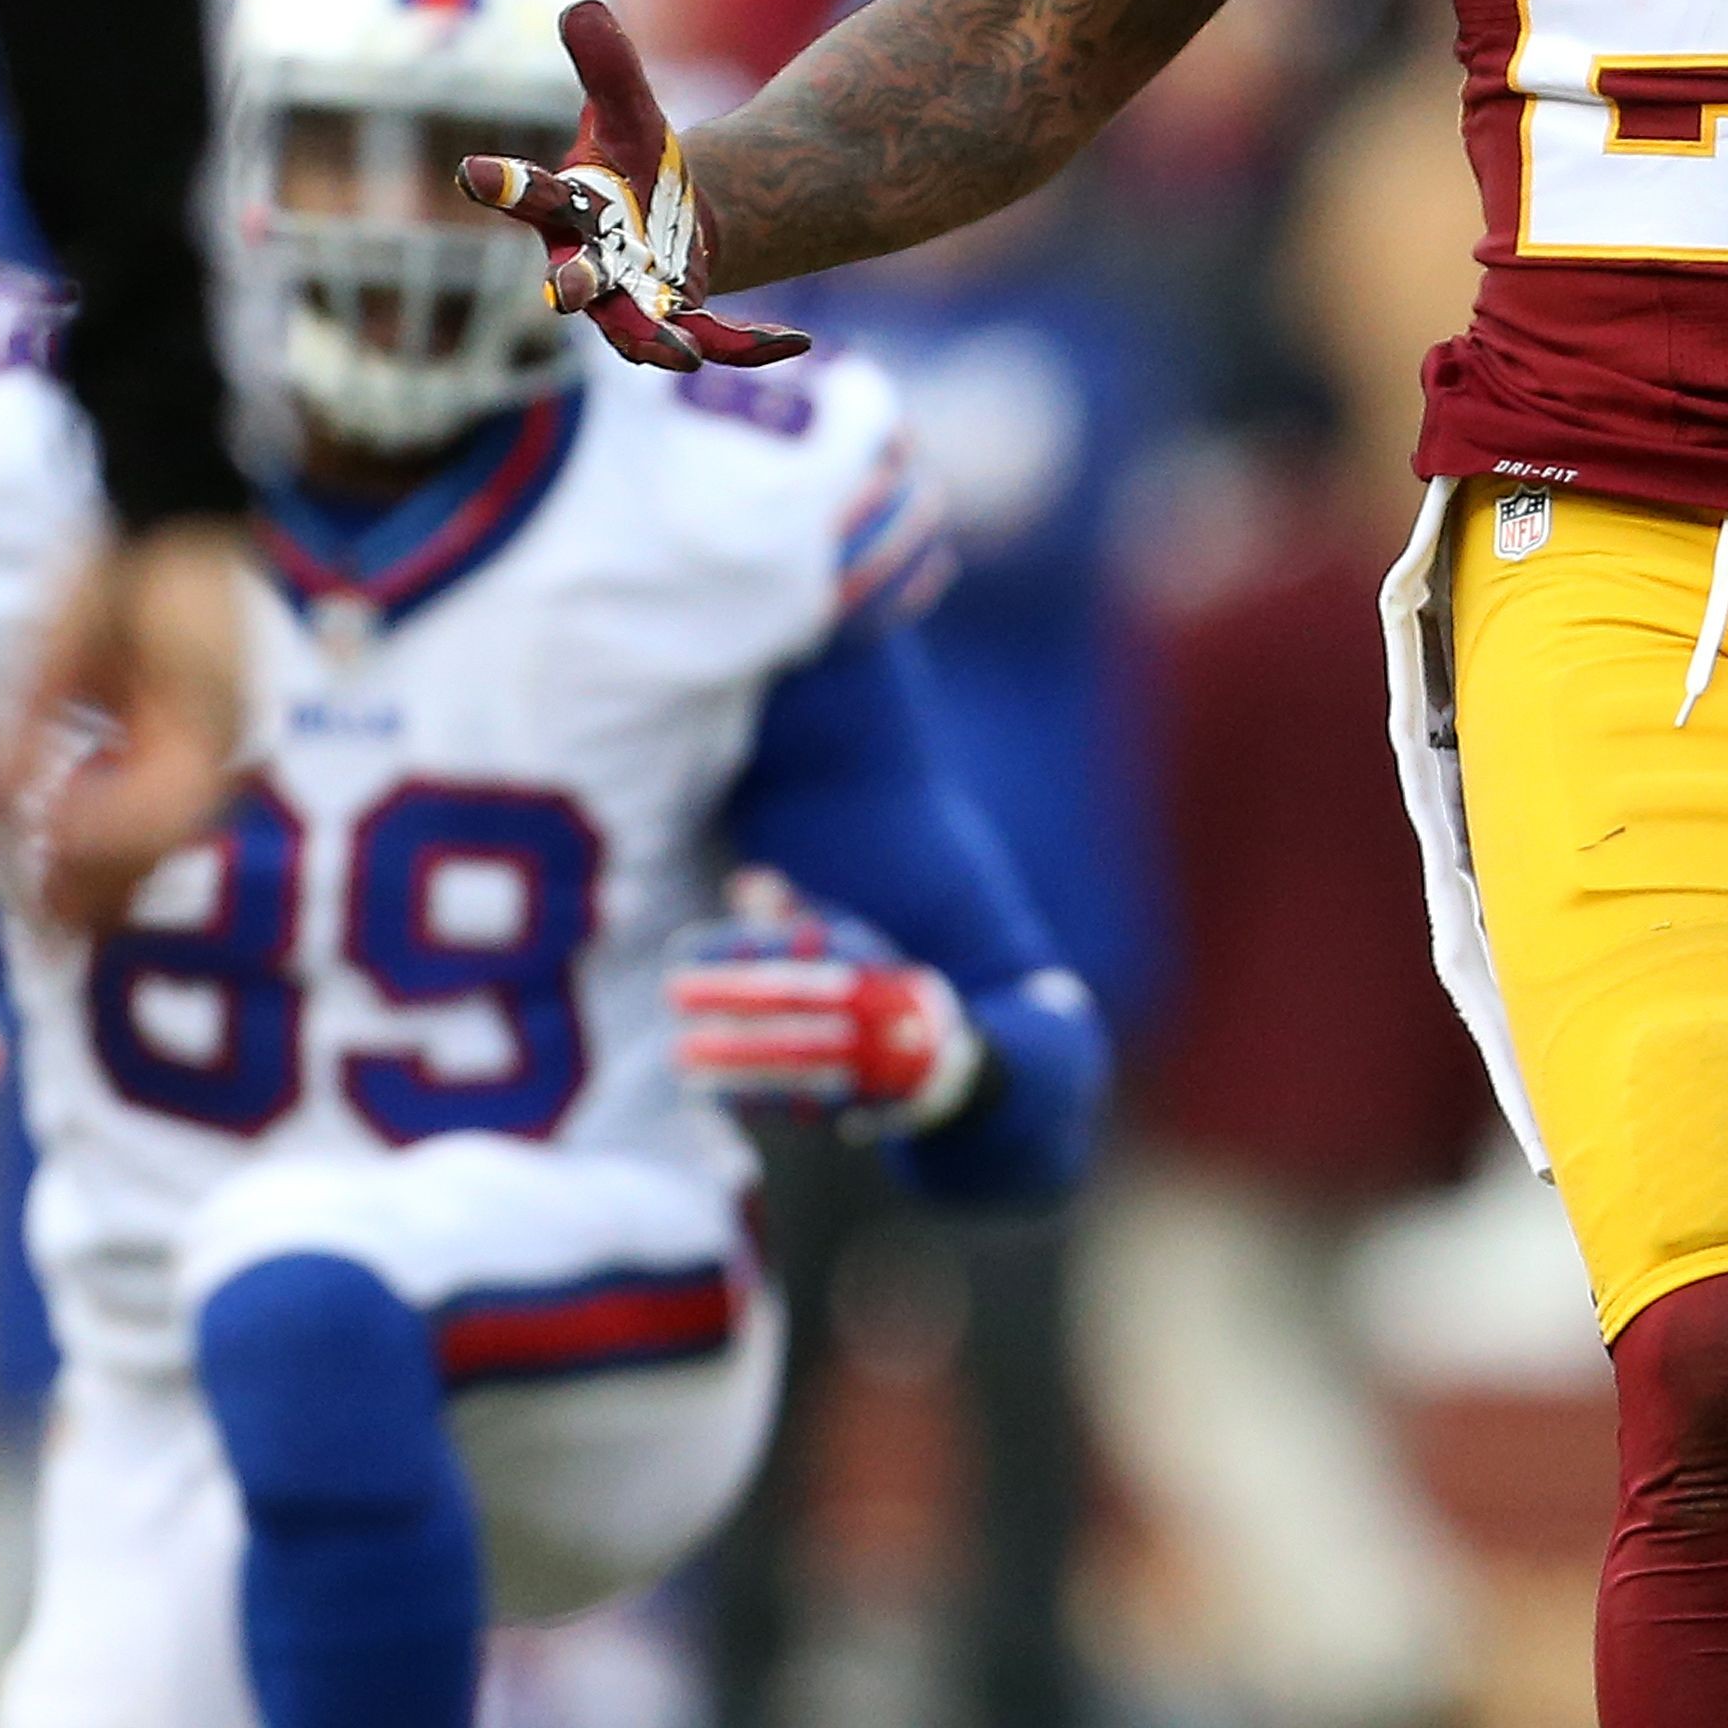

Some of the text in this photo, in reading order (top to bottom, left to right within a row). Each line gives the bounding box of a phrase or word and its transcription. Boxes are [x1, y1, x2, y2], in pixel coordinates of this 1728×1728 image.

[1492, 459, 1579, 483] DRI-FIT
[1503, 515, 1541, 549] NFL
[87, 767, 607, 1149] 89
